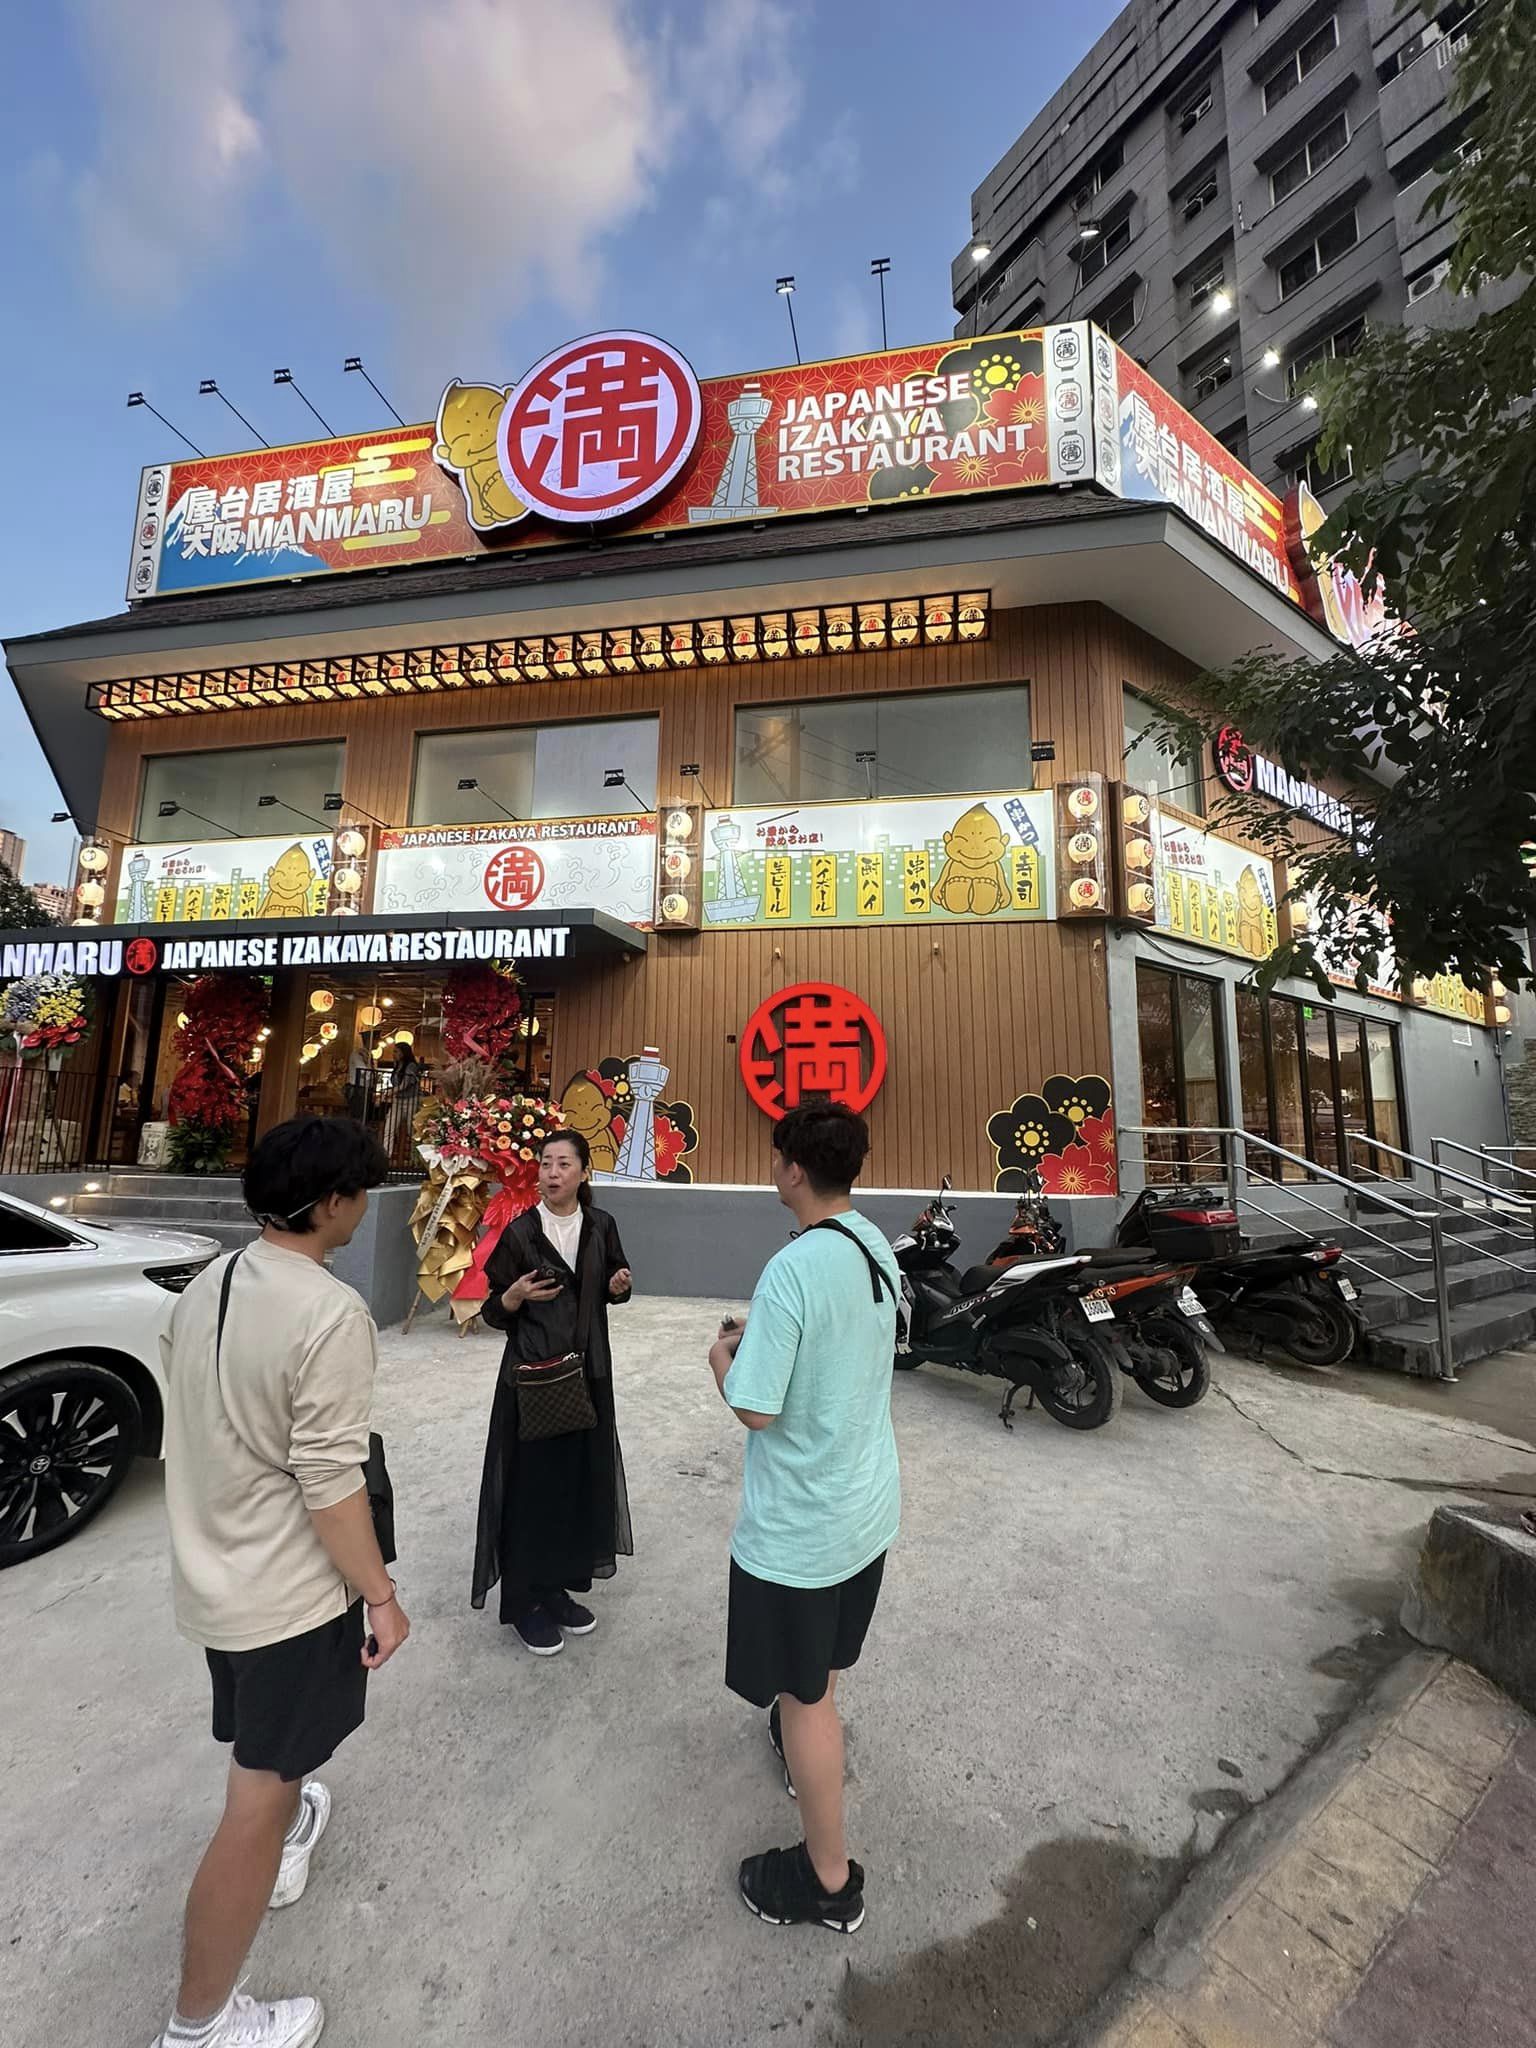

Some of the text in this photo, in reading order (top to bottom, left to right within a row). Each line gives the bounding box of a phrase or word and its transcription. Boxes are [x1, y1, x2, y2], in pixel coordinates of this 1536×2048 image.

[510, 343, 678, 498] 満
[779, 372, 972, 425] JAPANESE
[778, 423, 1033, 482] RESTAURANT
[779, 407, 943, 453] IZAKAYA
[184, 468, 355, 524] 屋台居酒屋
[181, 494, 432, 559] 大阪 MANMARU
[1181, 480, 1289, 596] MANMARU
[401, 820, 638, 846] JAPANESE IZAKAYA RESTAURANT
[487, 852, 537, 904] 満
[770, 861, 786, 913] 生ビール
[816, 858, 832, 913] ハイボール
[0, 941, 123, 977] NMARU
[161, 938, 277, 970] JAPANESE
[282, 934, 388, 965] IZAKAYA
[390, 928, 570, 961] RESTAURANT
[745, 990, 874, 1112] 満
